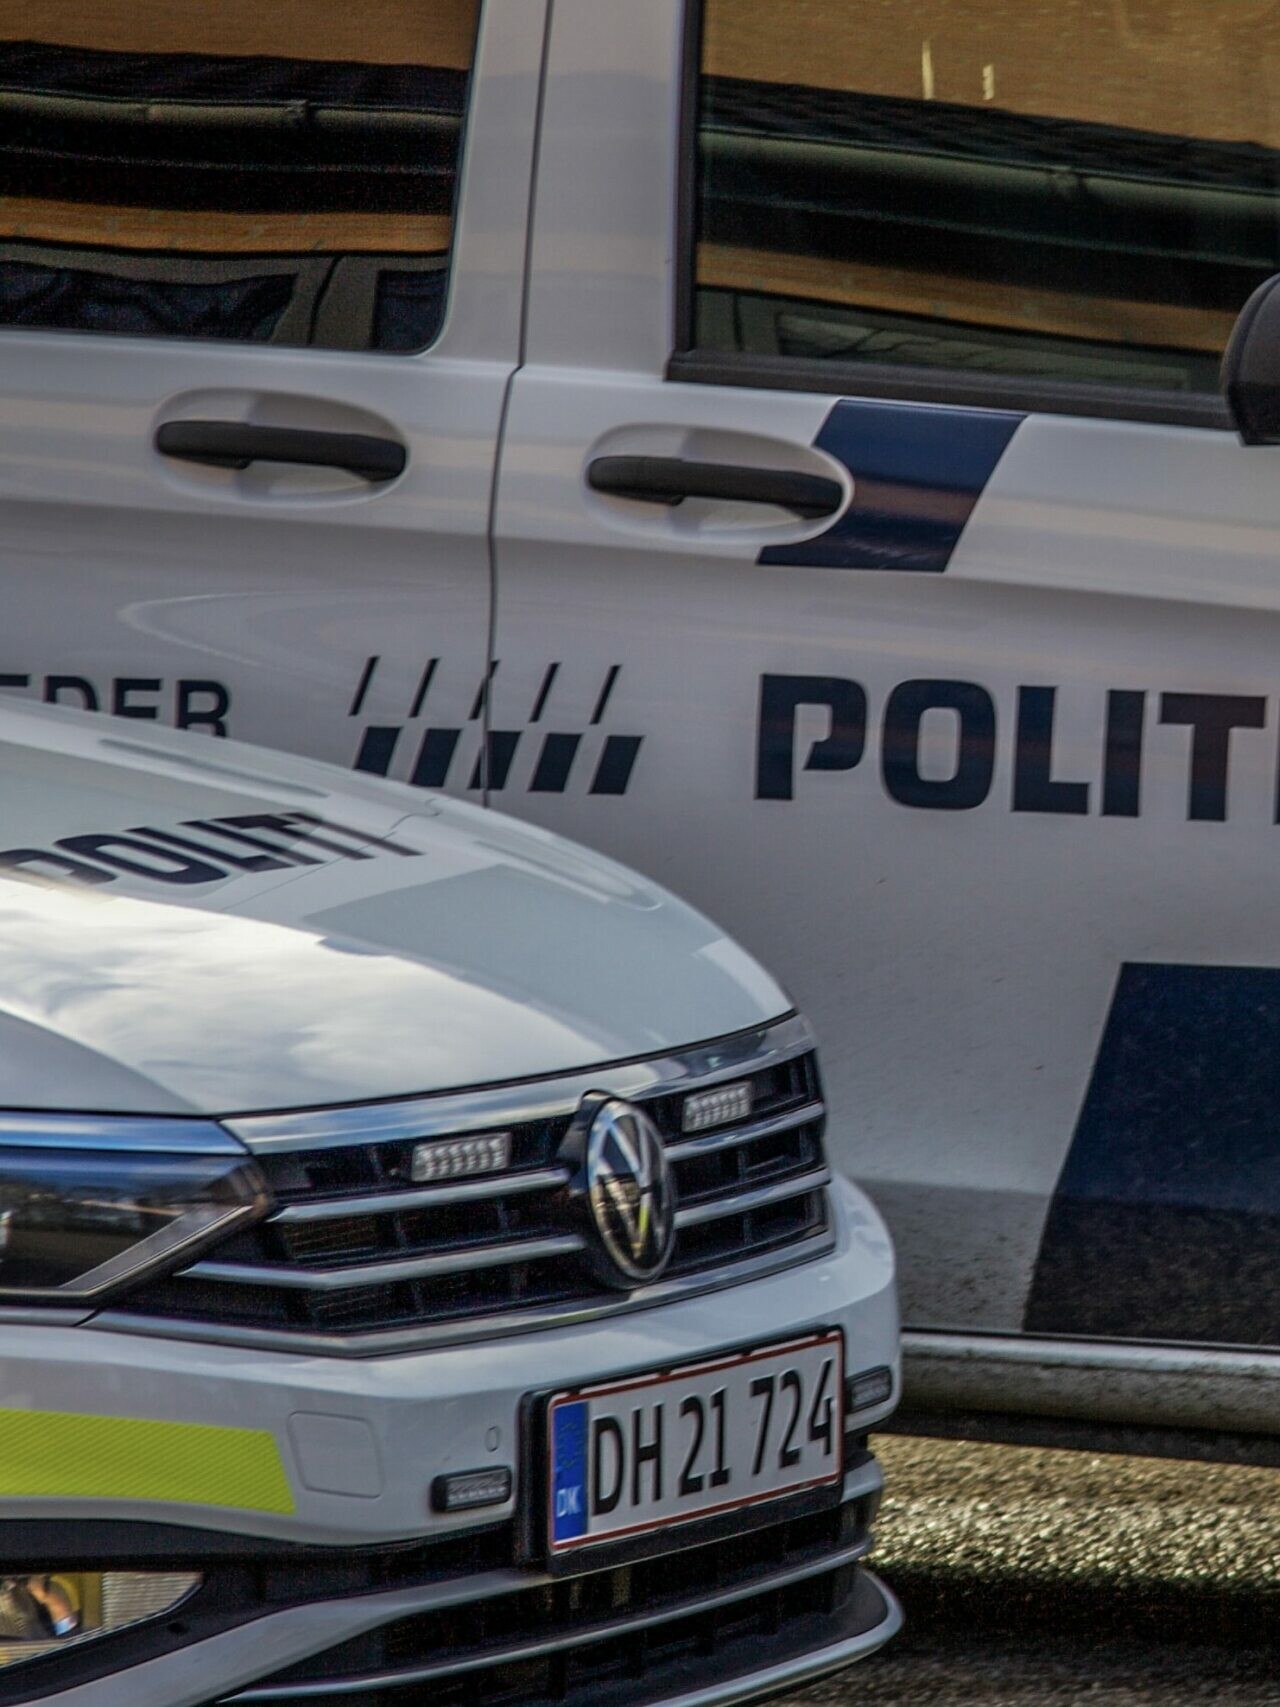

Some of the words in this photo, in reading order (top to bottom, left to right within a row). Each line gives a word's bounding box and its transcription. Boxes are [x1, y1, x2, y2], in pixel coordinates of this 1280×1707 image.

[592, 1402, 664, 1516] DH
[679, 1386, 730, 1497] 21
[751, 1358, 834, 1476] 724
[556, 1485, 582, 1518] DK
